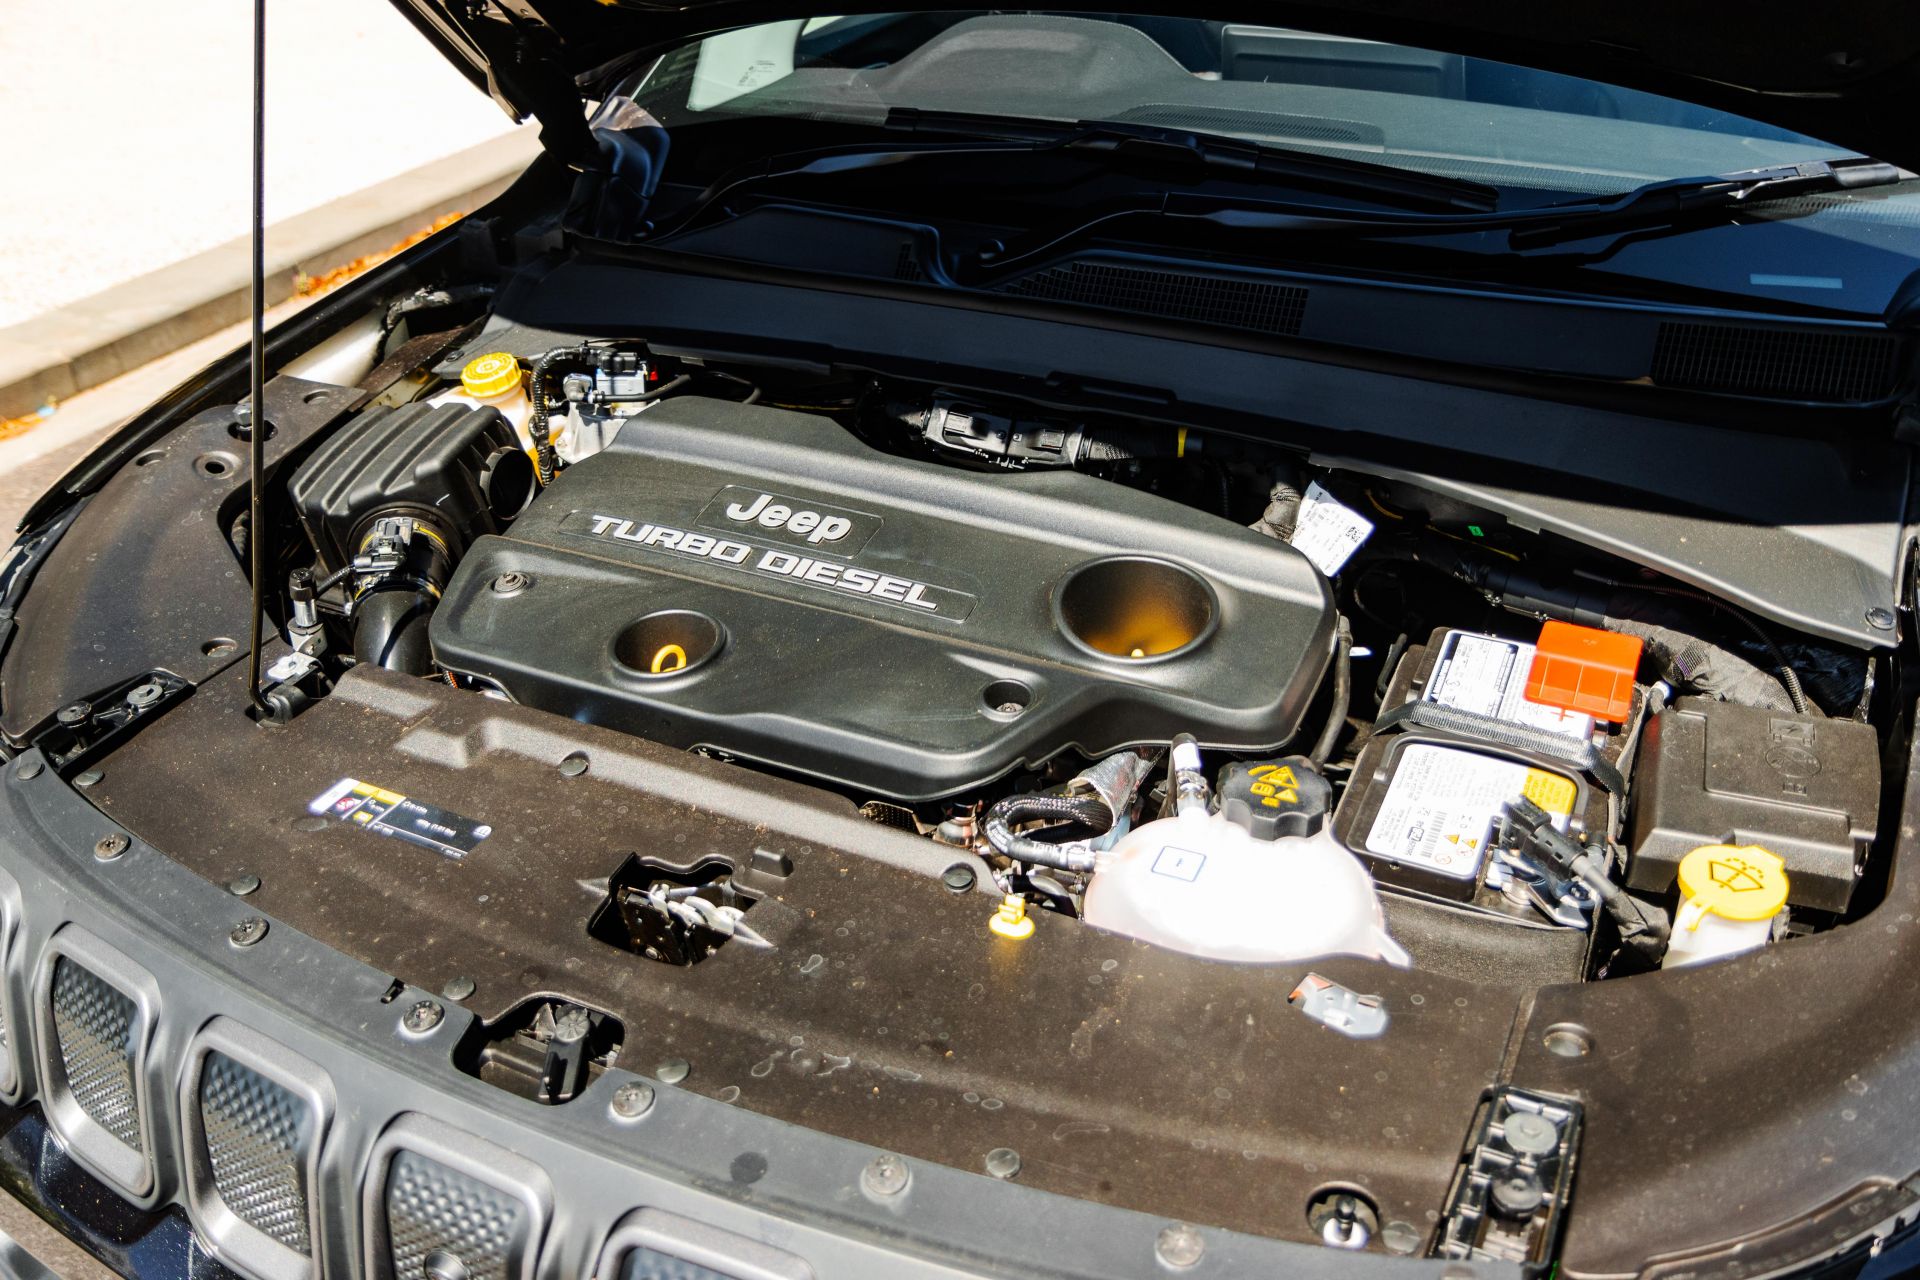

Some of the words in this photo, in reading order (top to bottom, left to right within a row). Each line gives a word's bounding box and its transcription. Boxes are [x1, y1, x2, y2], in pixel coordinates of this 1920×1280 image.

[726, 494, 852, 544] Jeep
[592, 515, 752, 564] TURBO
[757, 550, 937, 610] DIESEL
